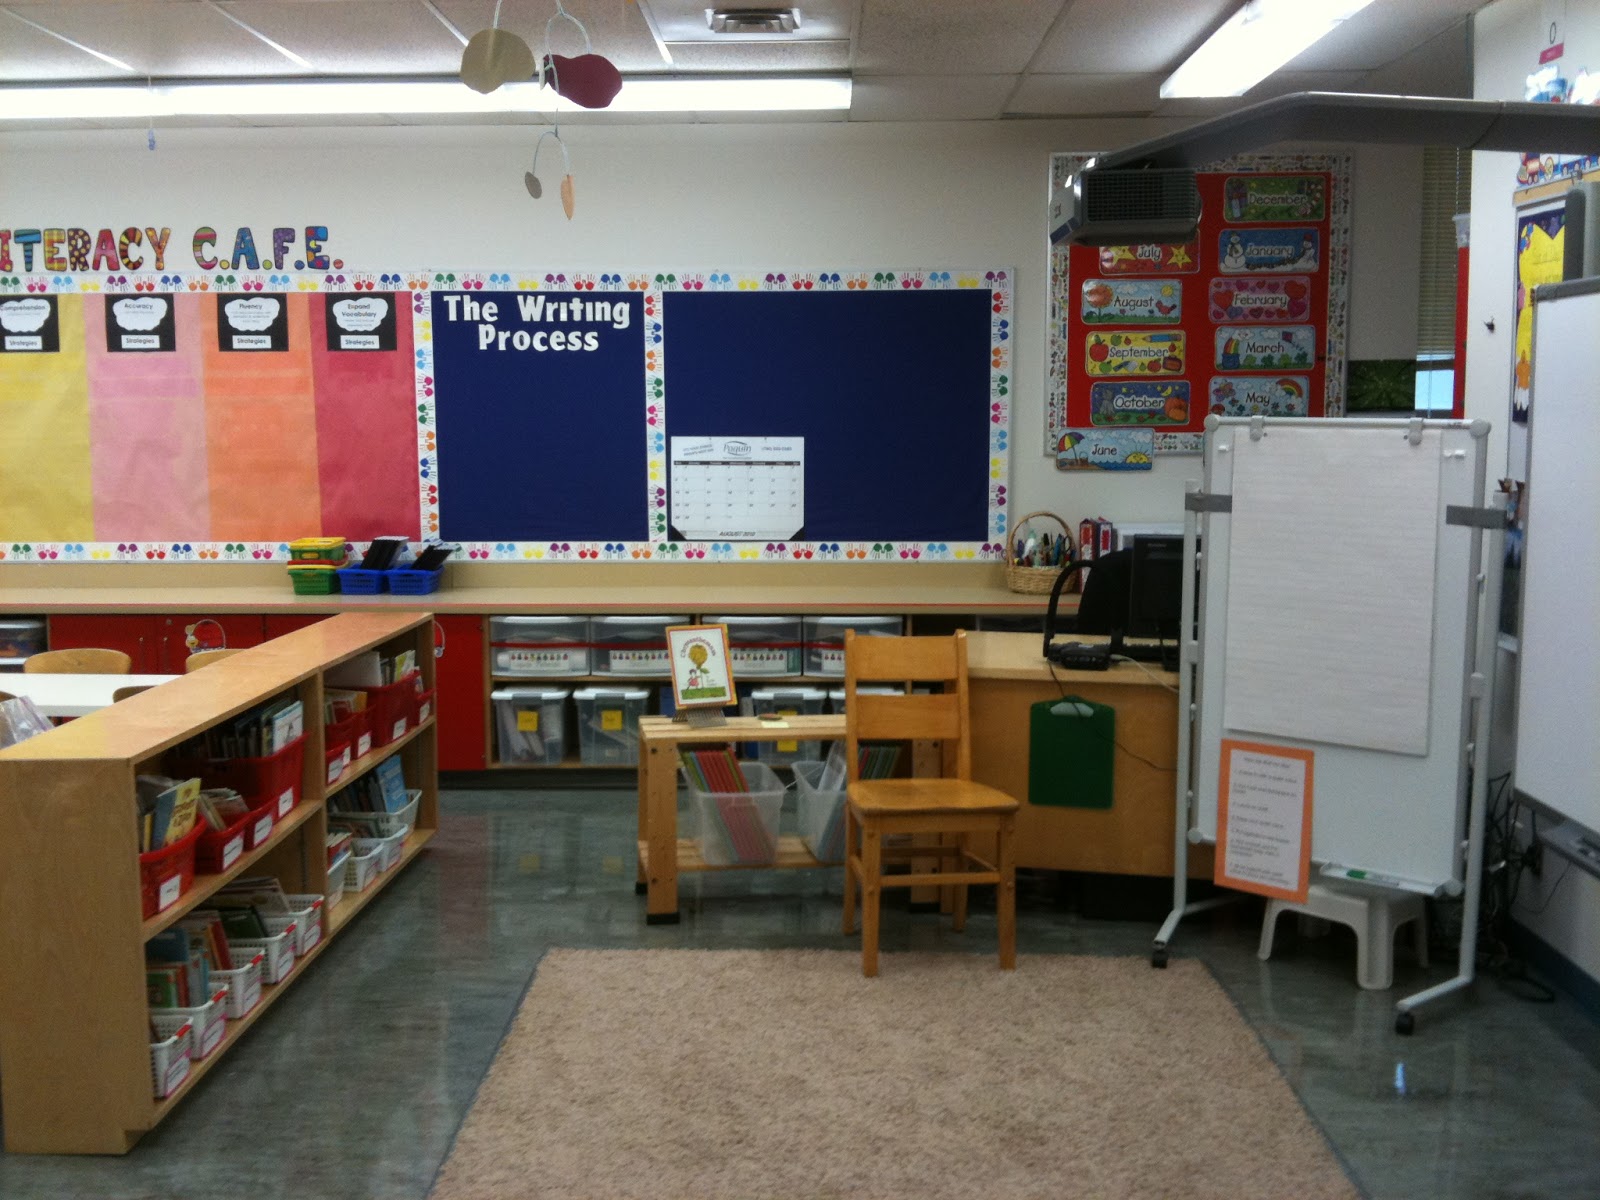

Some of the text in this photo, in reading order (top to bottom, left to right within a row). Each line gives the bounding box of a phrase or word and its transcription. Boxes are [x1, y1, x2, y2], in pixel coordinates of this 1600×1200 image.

[1249, 193, 1308, 206] December
[0, 228, 171, 272] ITERACY
[1137, 246, 1162, 261] July
[1246, 244, 1295, 257] January
[124, 302, 153, 310] Accuracy
[347, 303, 370, 311] Expand
[1113, 295, 1154, 310] August
[1234, 294, 1288, 309] February
[443, 294, 630, 330] The Writing
[126, 337, 155, 345] Strategies
[237, 337, 267, 346] Strategies
[345, 338, 375, 346] Strategies
[478, 323, 599, 351] Process
[1109, 346, 1169, 360] September
[1246, 341, 1285, 354] March
[1115, 396, 1164, 409] October
[1245, 393, 1270, 406] May
[1091, 444, 1117, 456] June
